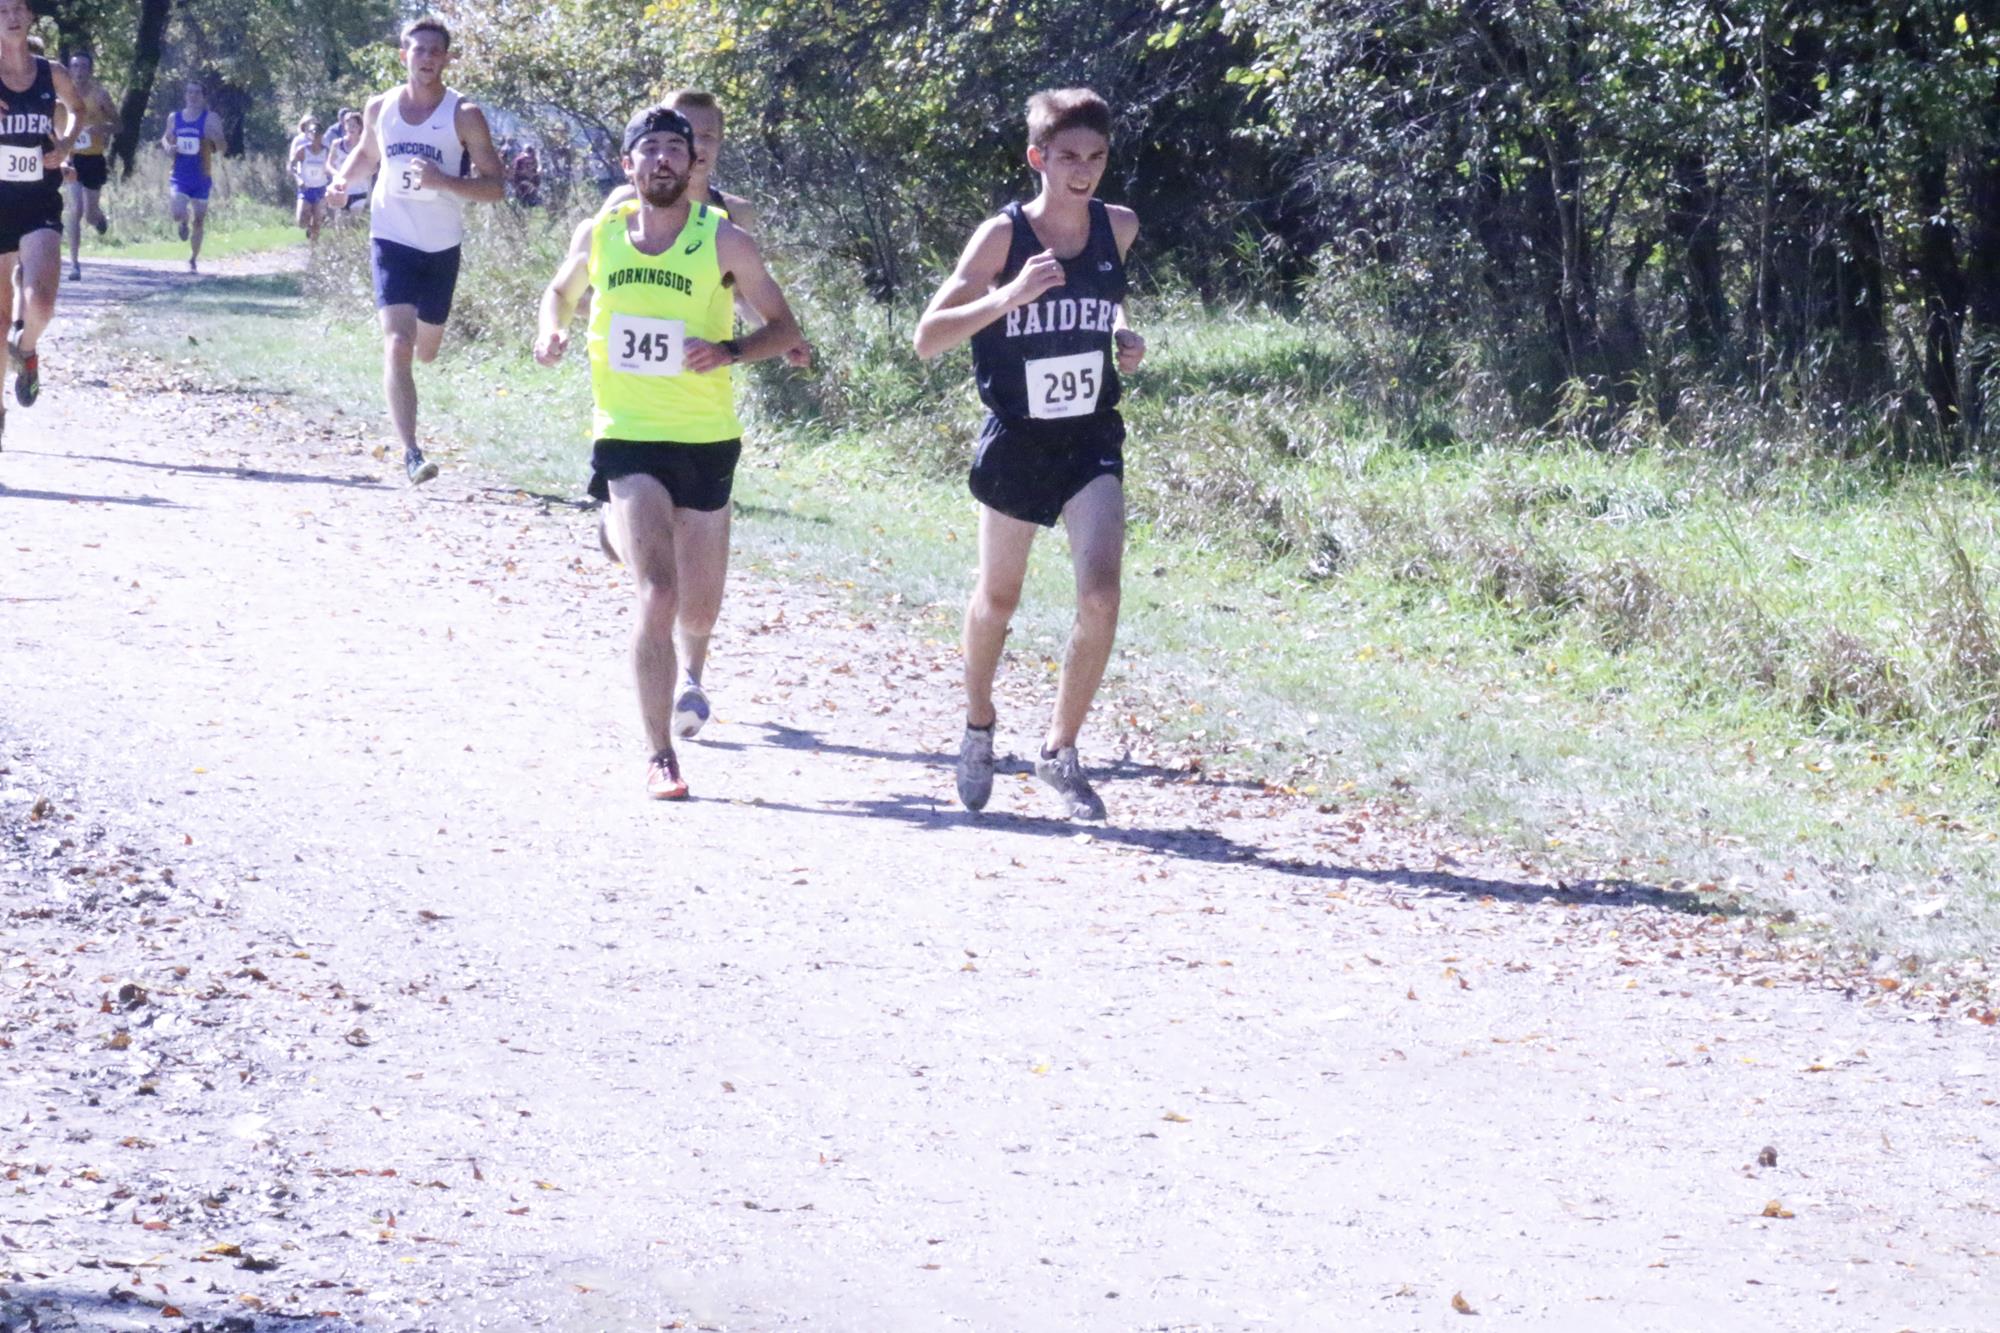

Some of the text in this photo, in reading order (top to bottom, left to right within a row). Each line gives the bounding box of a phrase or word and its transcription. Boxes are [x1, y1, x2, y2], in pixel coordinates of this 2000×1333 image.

[8, 154, 37, 173] 308
[386, 142, 444, 164] CONCORDIA
[608, 267, 693, 296] MORNINGSIDE
[622, 329, 669, 362] 345
[1044, 368, 1095, 404] 295
